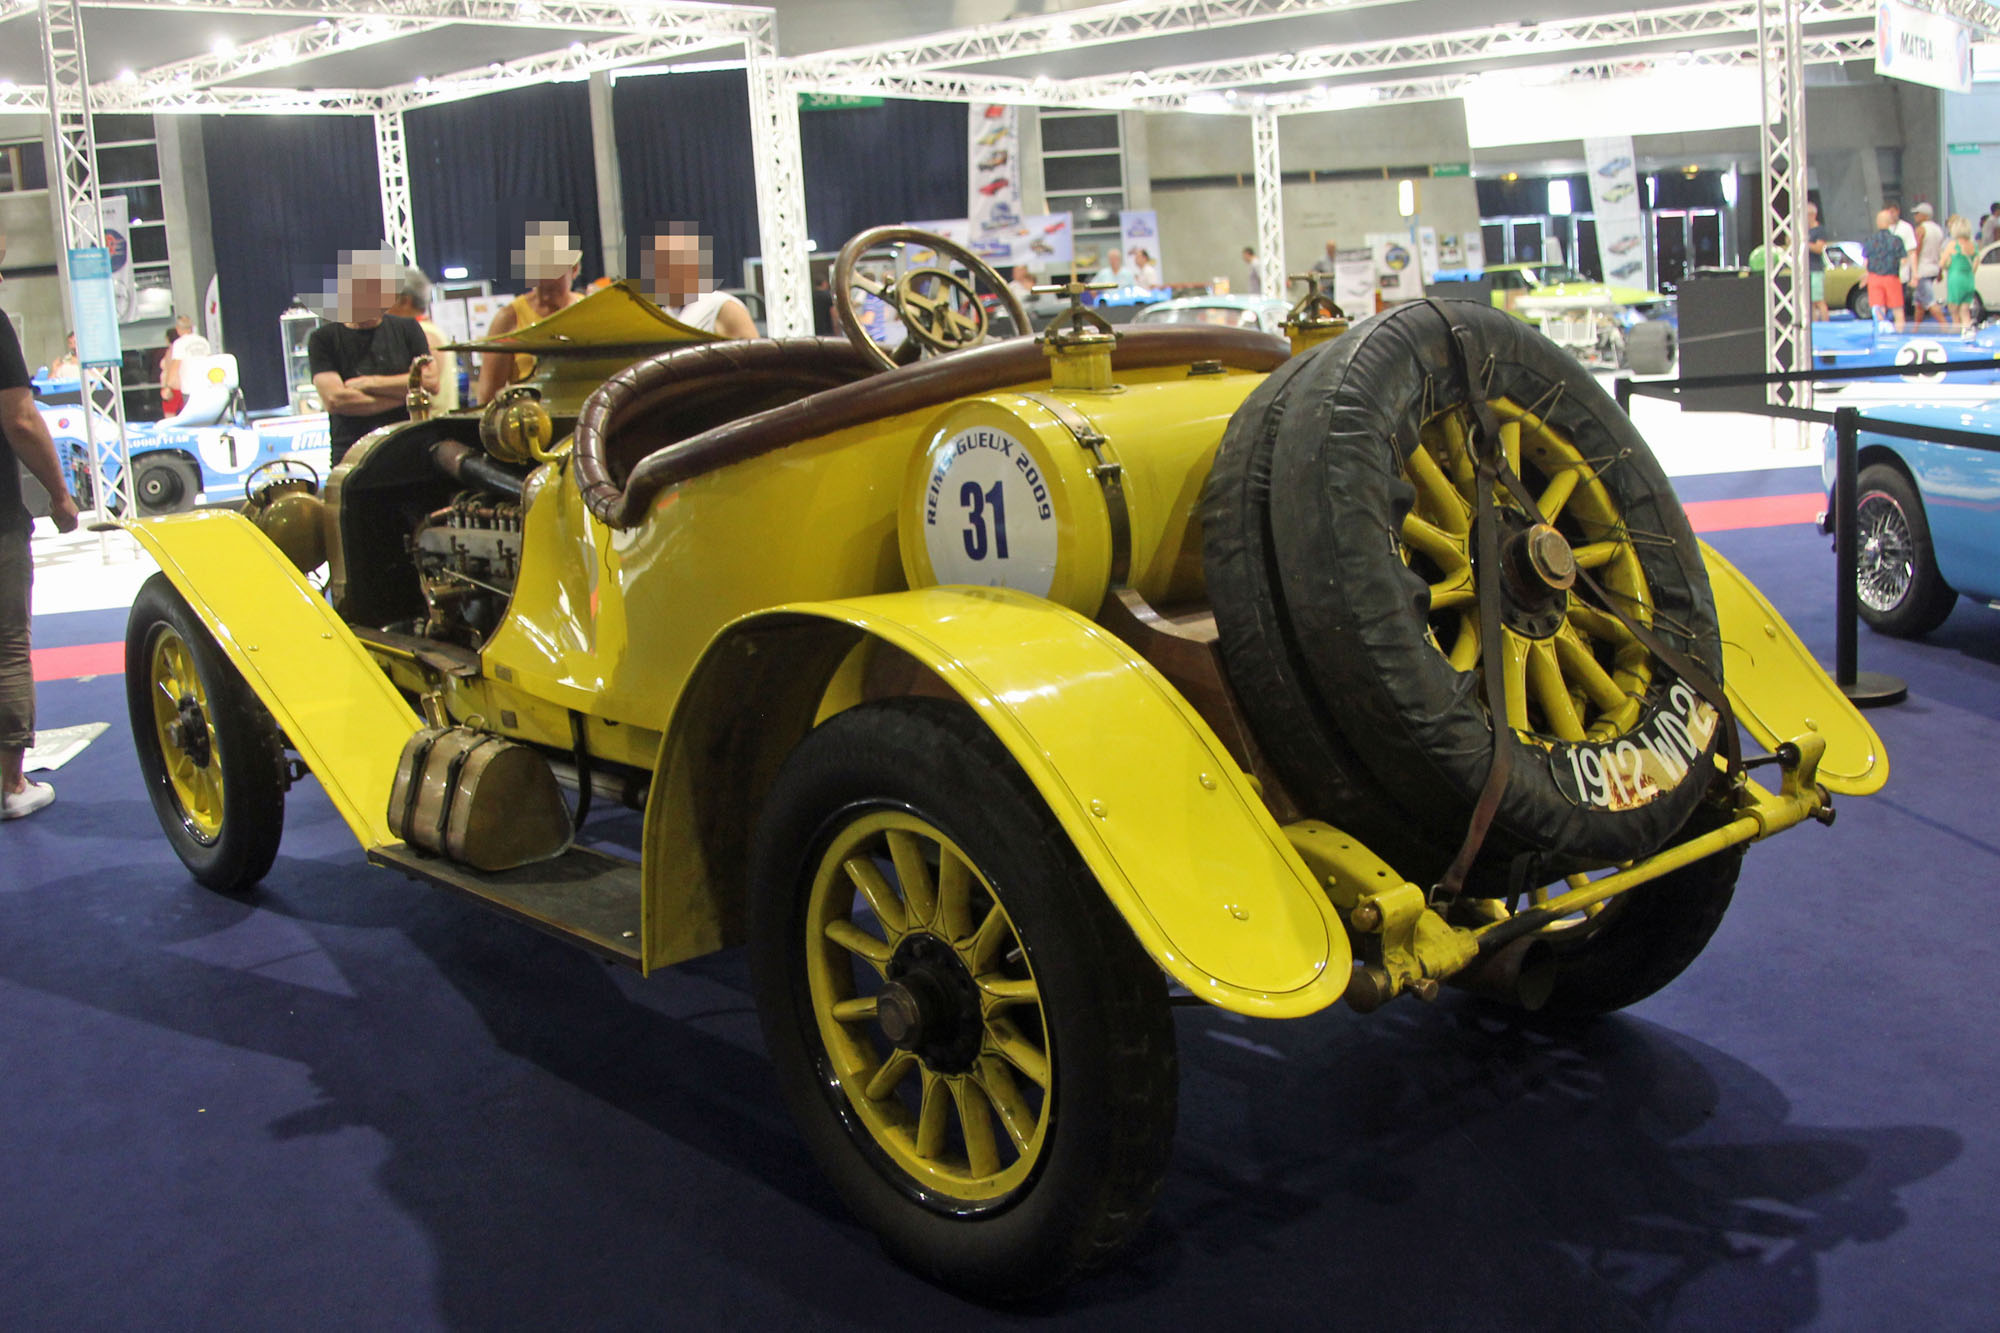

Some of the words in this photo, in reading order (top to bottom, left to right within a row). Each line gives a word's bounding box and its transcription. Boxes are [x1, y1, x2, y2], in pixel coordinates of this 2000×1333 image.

[1900, 32, 1933, 62] MATRA
[219, 433, 237, 468] 1
[927, 432, 1014, 526] REIMS-GUEUX
[1016, 453, 1052, 521] 2009
[960, 480, 1009, 562] 31
[1567, 739, 1659, 806] 1912
[1638, 710, 1698, 782] WD
